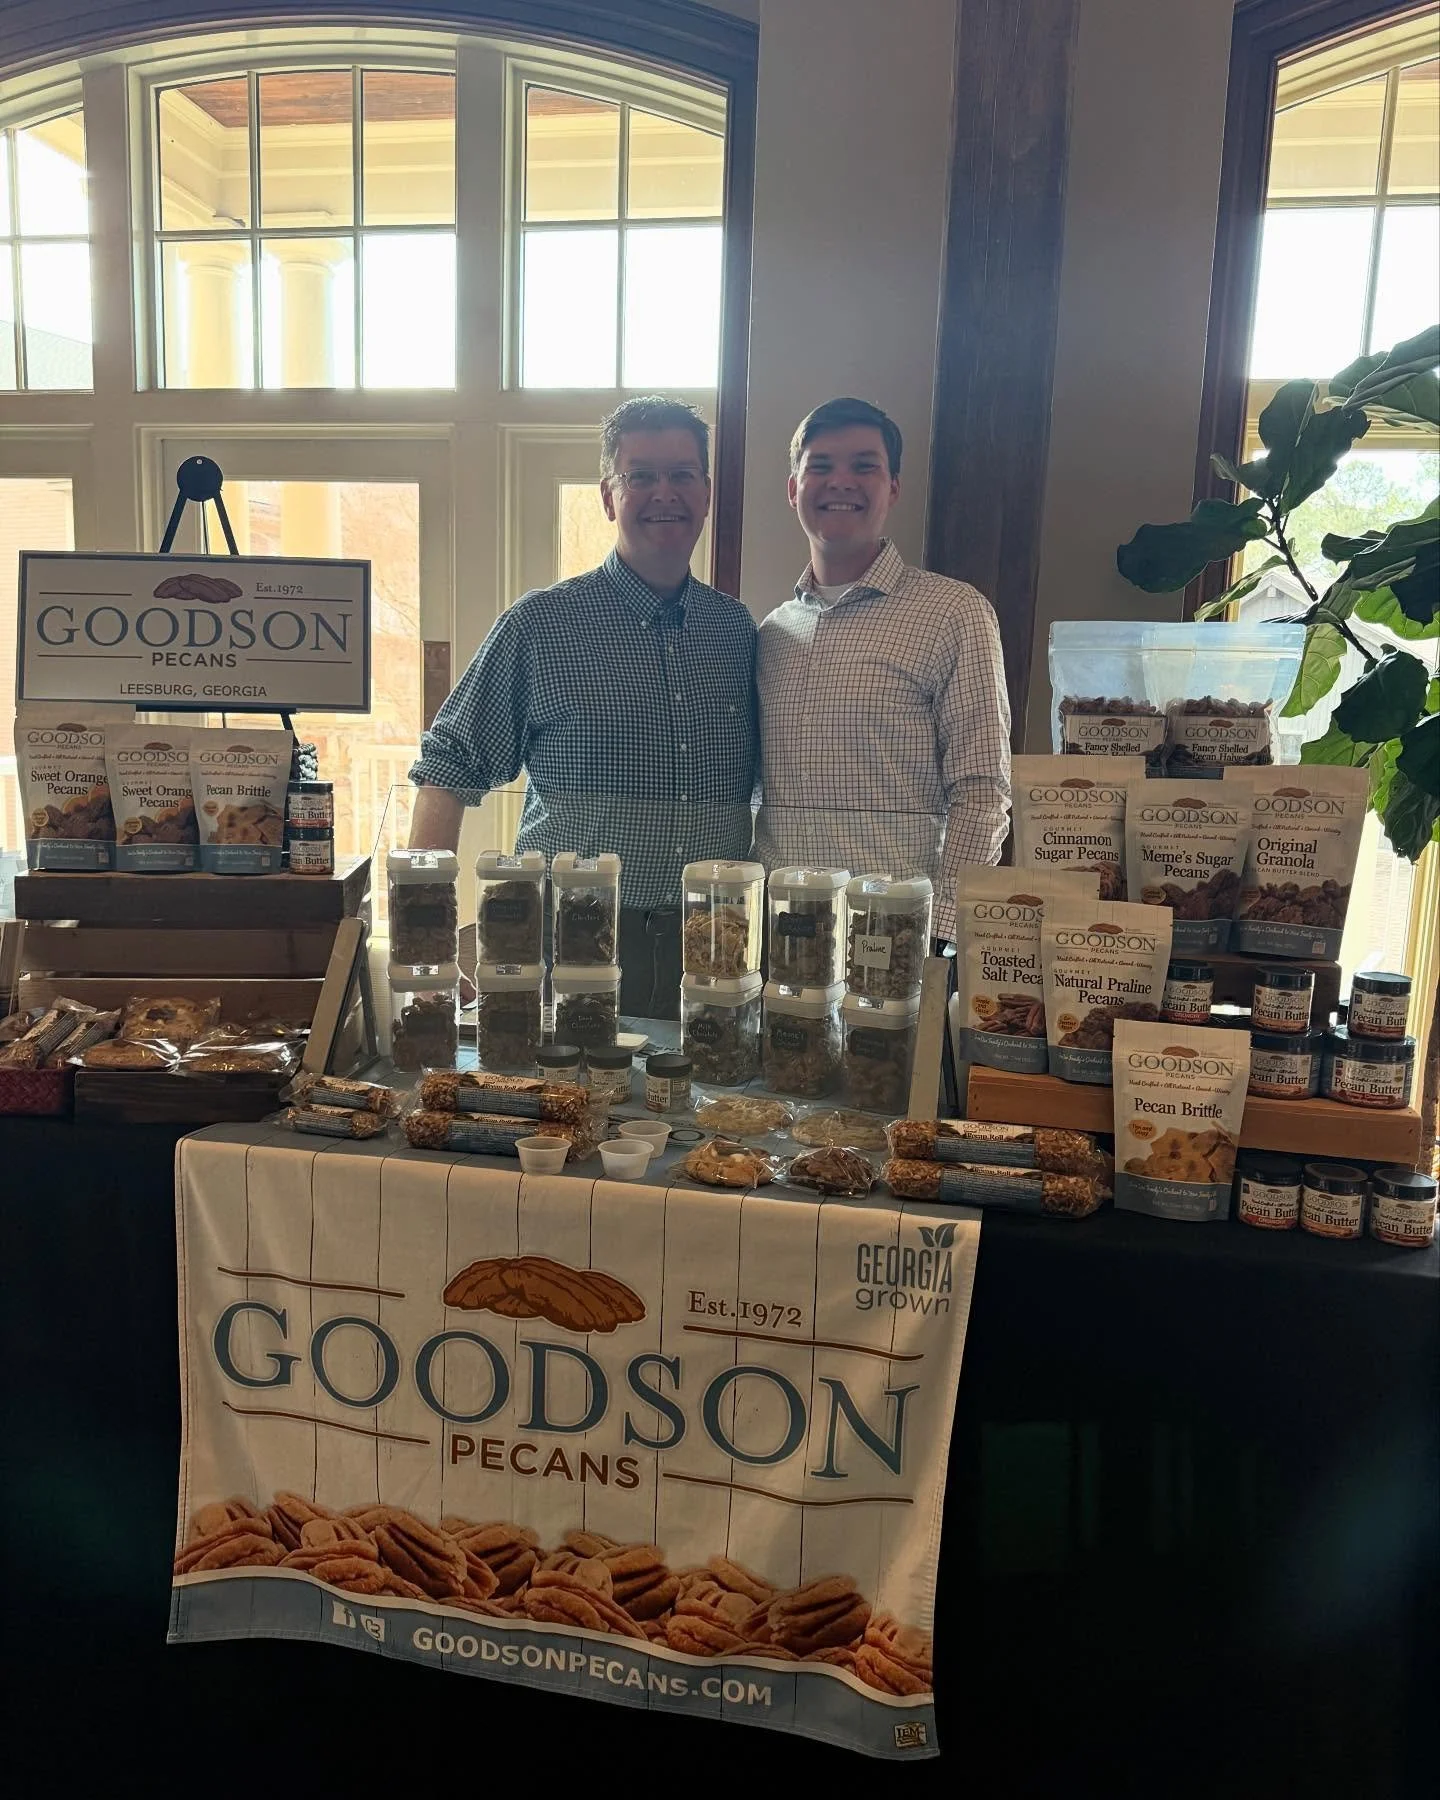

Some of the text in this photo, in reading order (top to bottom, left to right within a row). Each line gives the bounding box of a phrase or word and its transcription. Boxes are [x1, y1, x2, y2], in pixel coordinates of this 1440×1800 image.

[256, 582, 304, 595] Est.1972
[36, 605, 353, 652] GOODSON
[151, 652, 237, 668] PECANS
[120, 683, 267, 698] LEESBURG, GEORGIA
[1079, 726, 1149, 738] GOODSON
[1185, 727, 1257, 739] GOODSON
[1085, 742, 1140, 752] Fancy Shelled
[1192, 744, 1249, 753] Fancy Shelled
[200, 752, 280, 765] GOODSON
[31, 770, 61, 783] Sweet
[47, 783, 88, 795] Pecans
[122, 785, 152, 797] Sweet
[207, 785, 272, 797] Pecan Brittle
[1030, 789, 1127, 803] GOODSON
[140, 797, 179, 808] Pecans
[1141, 809, 1239, 825] GOODSON
[1043, 832, 1112, 846] Cinnamon
[1258, 837, 1317, 854] Original
[305, 857, 329, 865] Butter
[1035, 847, 1119, 863] Sugar Pecans
[1142, 849, 1233, 868] Meme's Sugar
[1257, 852, 1314, 869] Granola
[1164, 865, 1210, 878] Pecans
[862, 940, 886, 953] Praline
[1056, 932, 1156, 952] GOODSON
[981, 951, 1035, 968] Toasted
[982, 967, 1008, 982] Salt
[1054, 974, 1152, 994] Natural Praline
[1078, 990, 1124, 1006] Pecans
[1254, 1006, 1281, 1020] Pecan
[1353, 1011, 1382, 1025] Pecan
[1129, 1054, 1234, 1076] GOODSON
[1277, 1074, 1308, 1085] Butter
[1334, 1077, 1365, 1092] Pecan
[1370, 1084, 1402, 1095] Butter
[1134, 1098, 1223, 1119] Pecan Brittle
[1241, 1200, 1270, 1217] Pecan
[1325, 1215, 1358, 1227] Butter
[1370, 1216, 1398, 1232] Pecan
[857, 1243, 952, 1293] GEORGIA
[686, 1289, 803, 1328] Est.1972
[856, 1288, 950, 1315] grown
[211, 1300, 920, 1479] GOODSON
[450, 1434, 641, 1490] PECANS
[411, 1627, 773, 1706] GOODSONPECANS.COM
